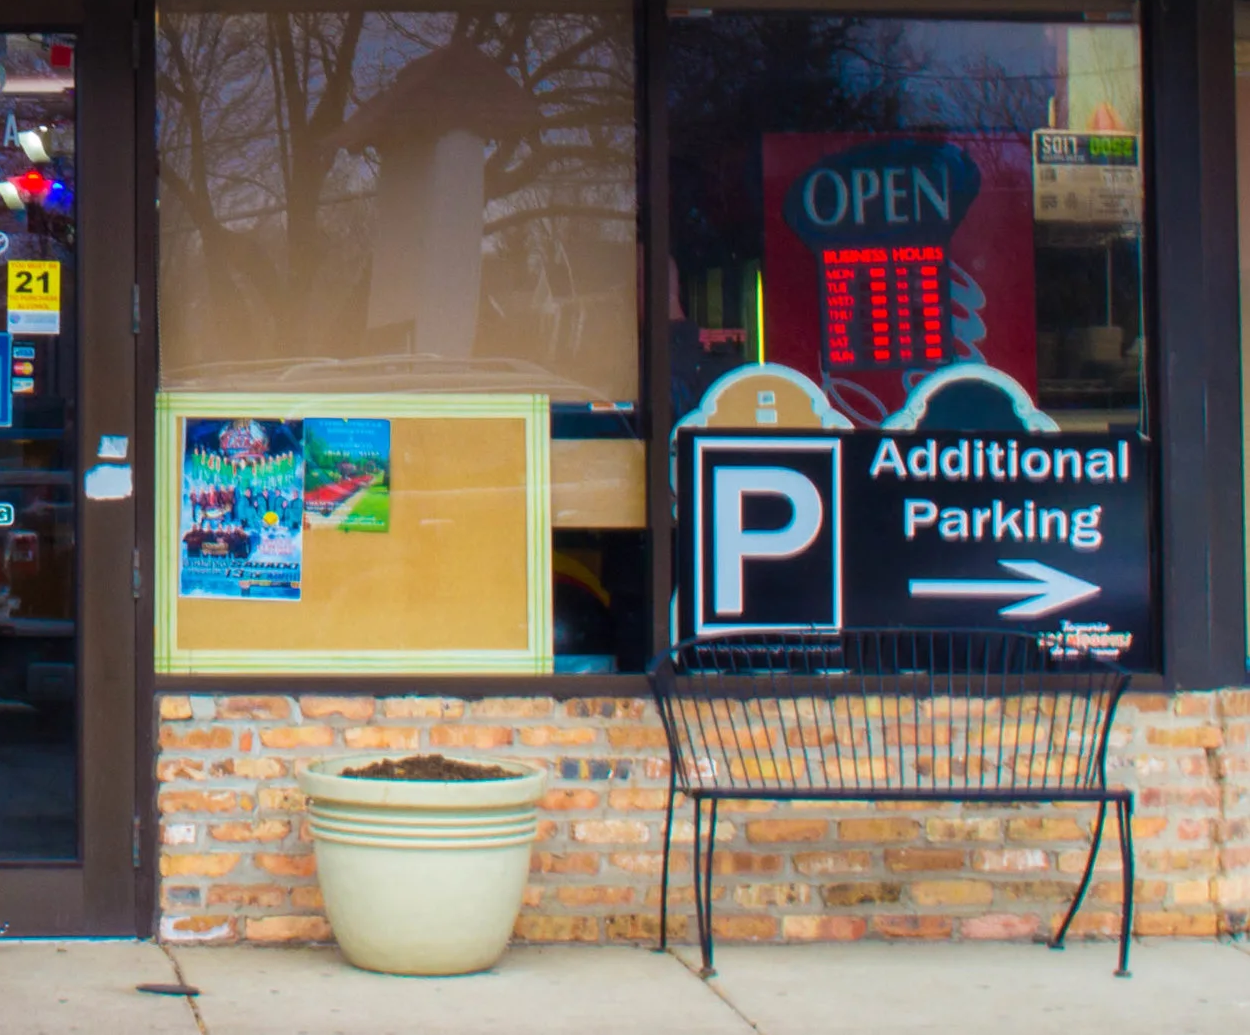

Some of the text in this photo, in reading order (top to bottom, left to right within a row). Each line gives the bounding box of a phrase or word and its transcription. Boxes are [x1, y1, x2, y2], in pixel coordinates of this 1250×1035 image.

[3, 112, 20, 147] A
[803, 166, 950, 226] OPEN
[892, 246, 944, 262] HOURS
[15, 270, 50, 294] 21
[870, 438, 1130, 480] Additional
[714, 466, 823, 615] P
[904, 499, 1103, 549] Parking
